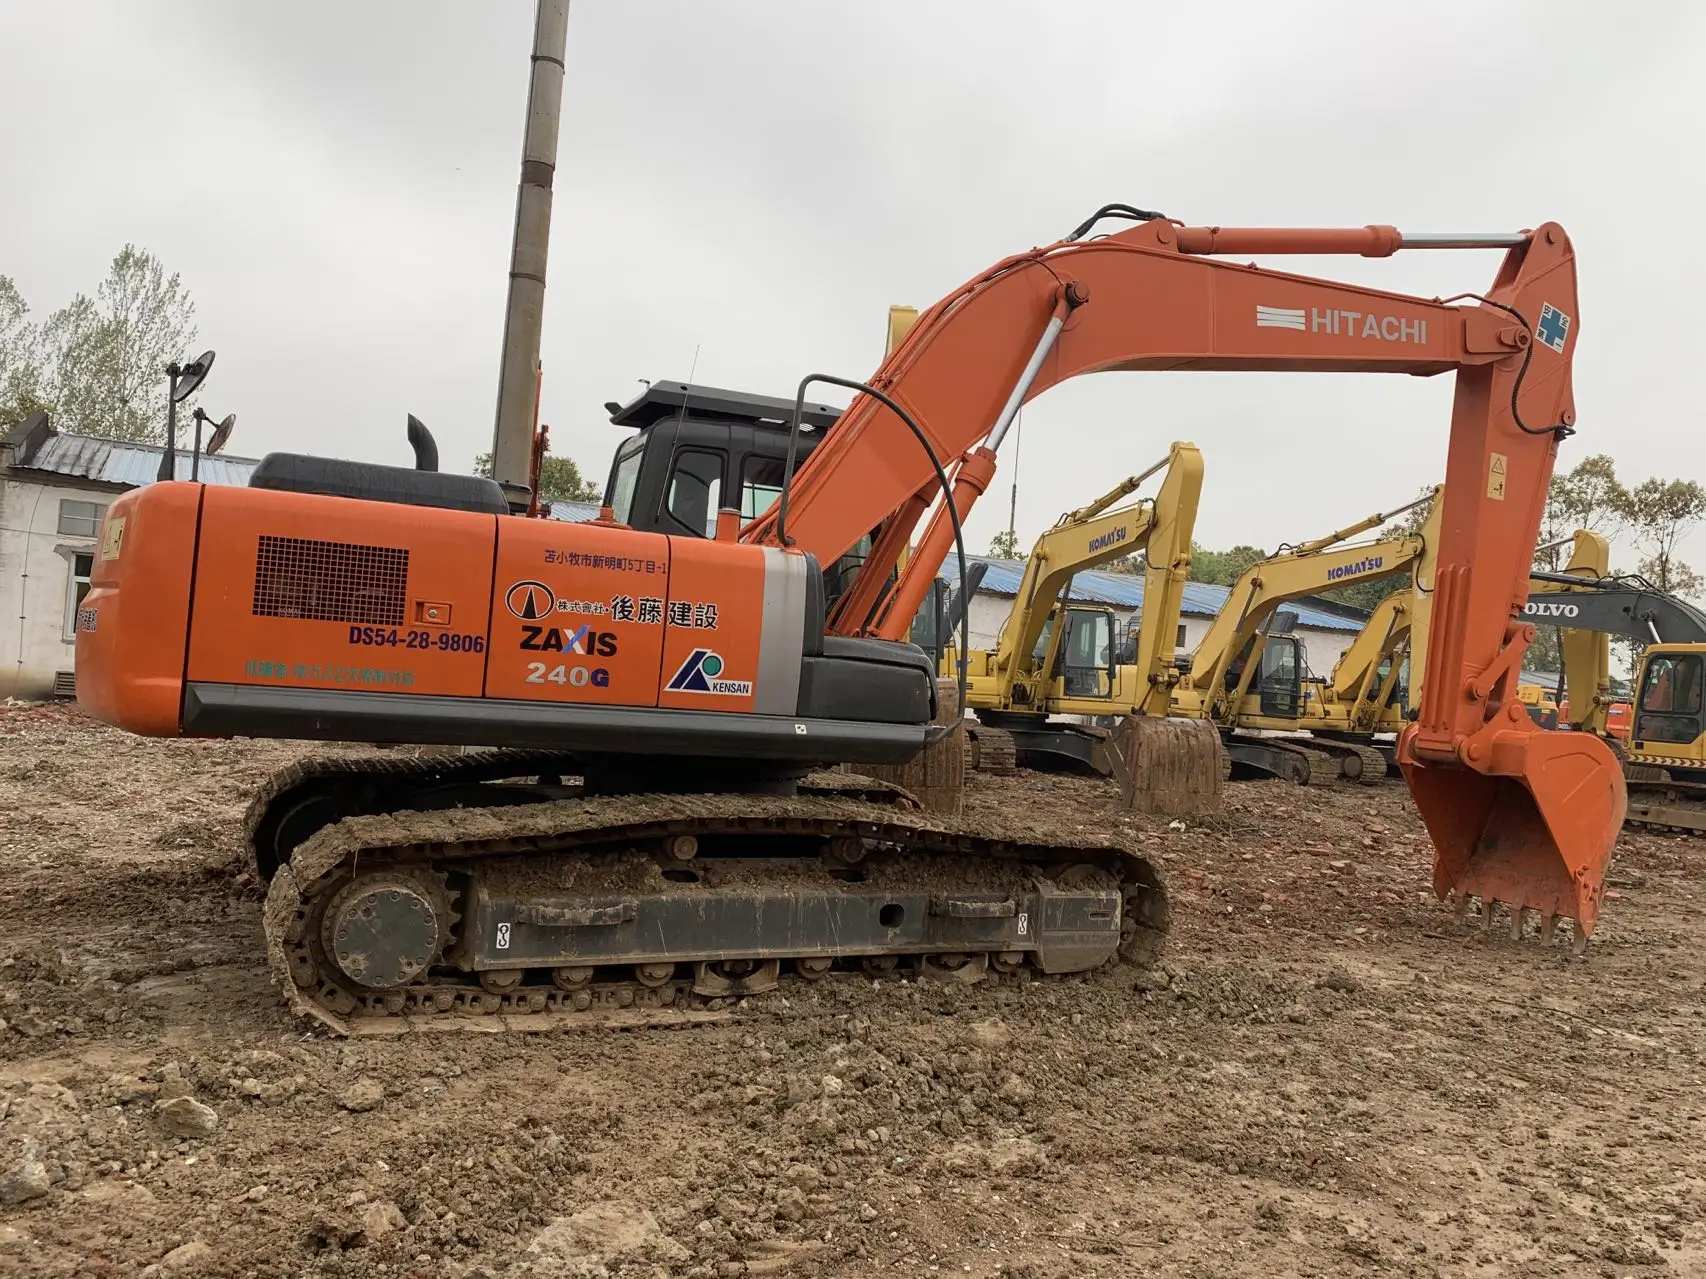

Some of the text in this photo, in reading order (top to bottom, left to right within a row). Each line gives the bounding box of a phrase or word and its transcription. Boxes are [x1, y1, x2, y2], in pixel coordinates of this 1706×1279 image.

[1311, 307, 1427, 345] HITACHI
[1088, 526, 1127, 553] KOMATSU
[1327, 556, 1383, 580] KOMATSU
[1524, 602, 1579, 618] OLVO
[349, 626, 484, 653] DS54-28-9806
[519, 624, 618, 657] ZAXIS
[525, 662, 610, 688] 240G
[712, 682, 750, 694] KENSAN
